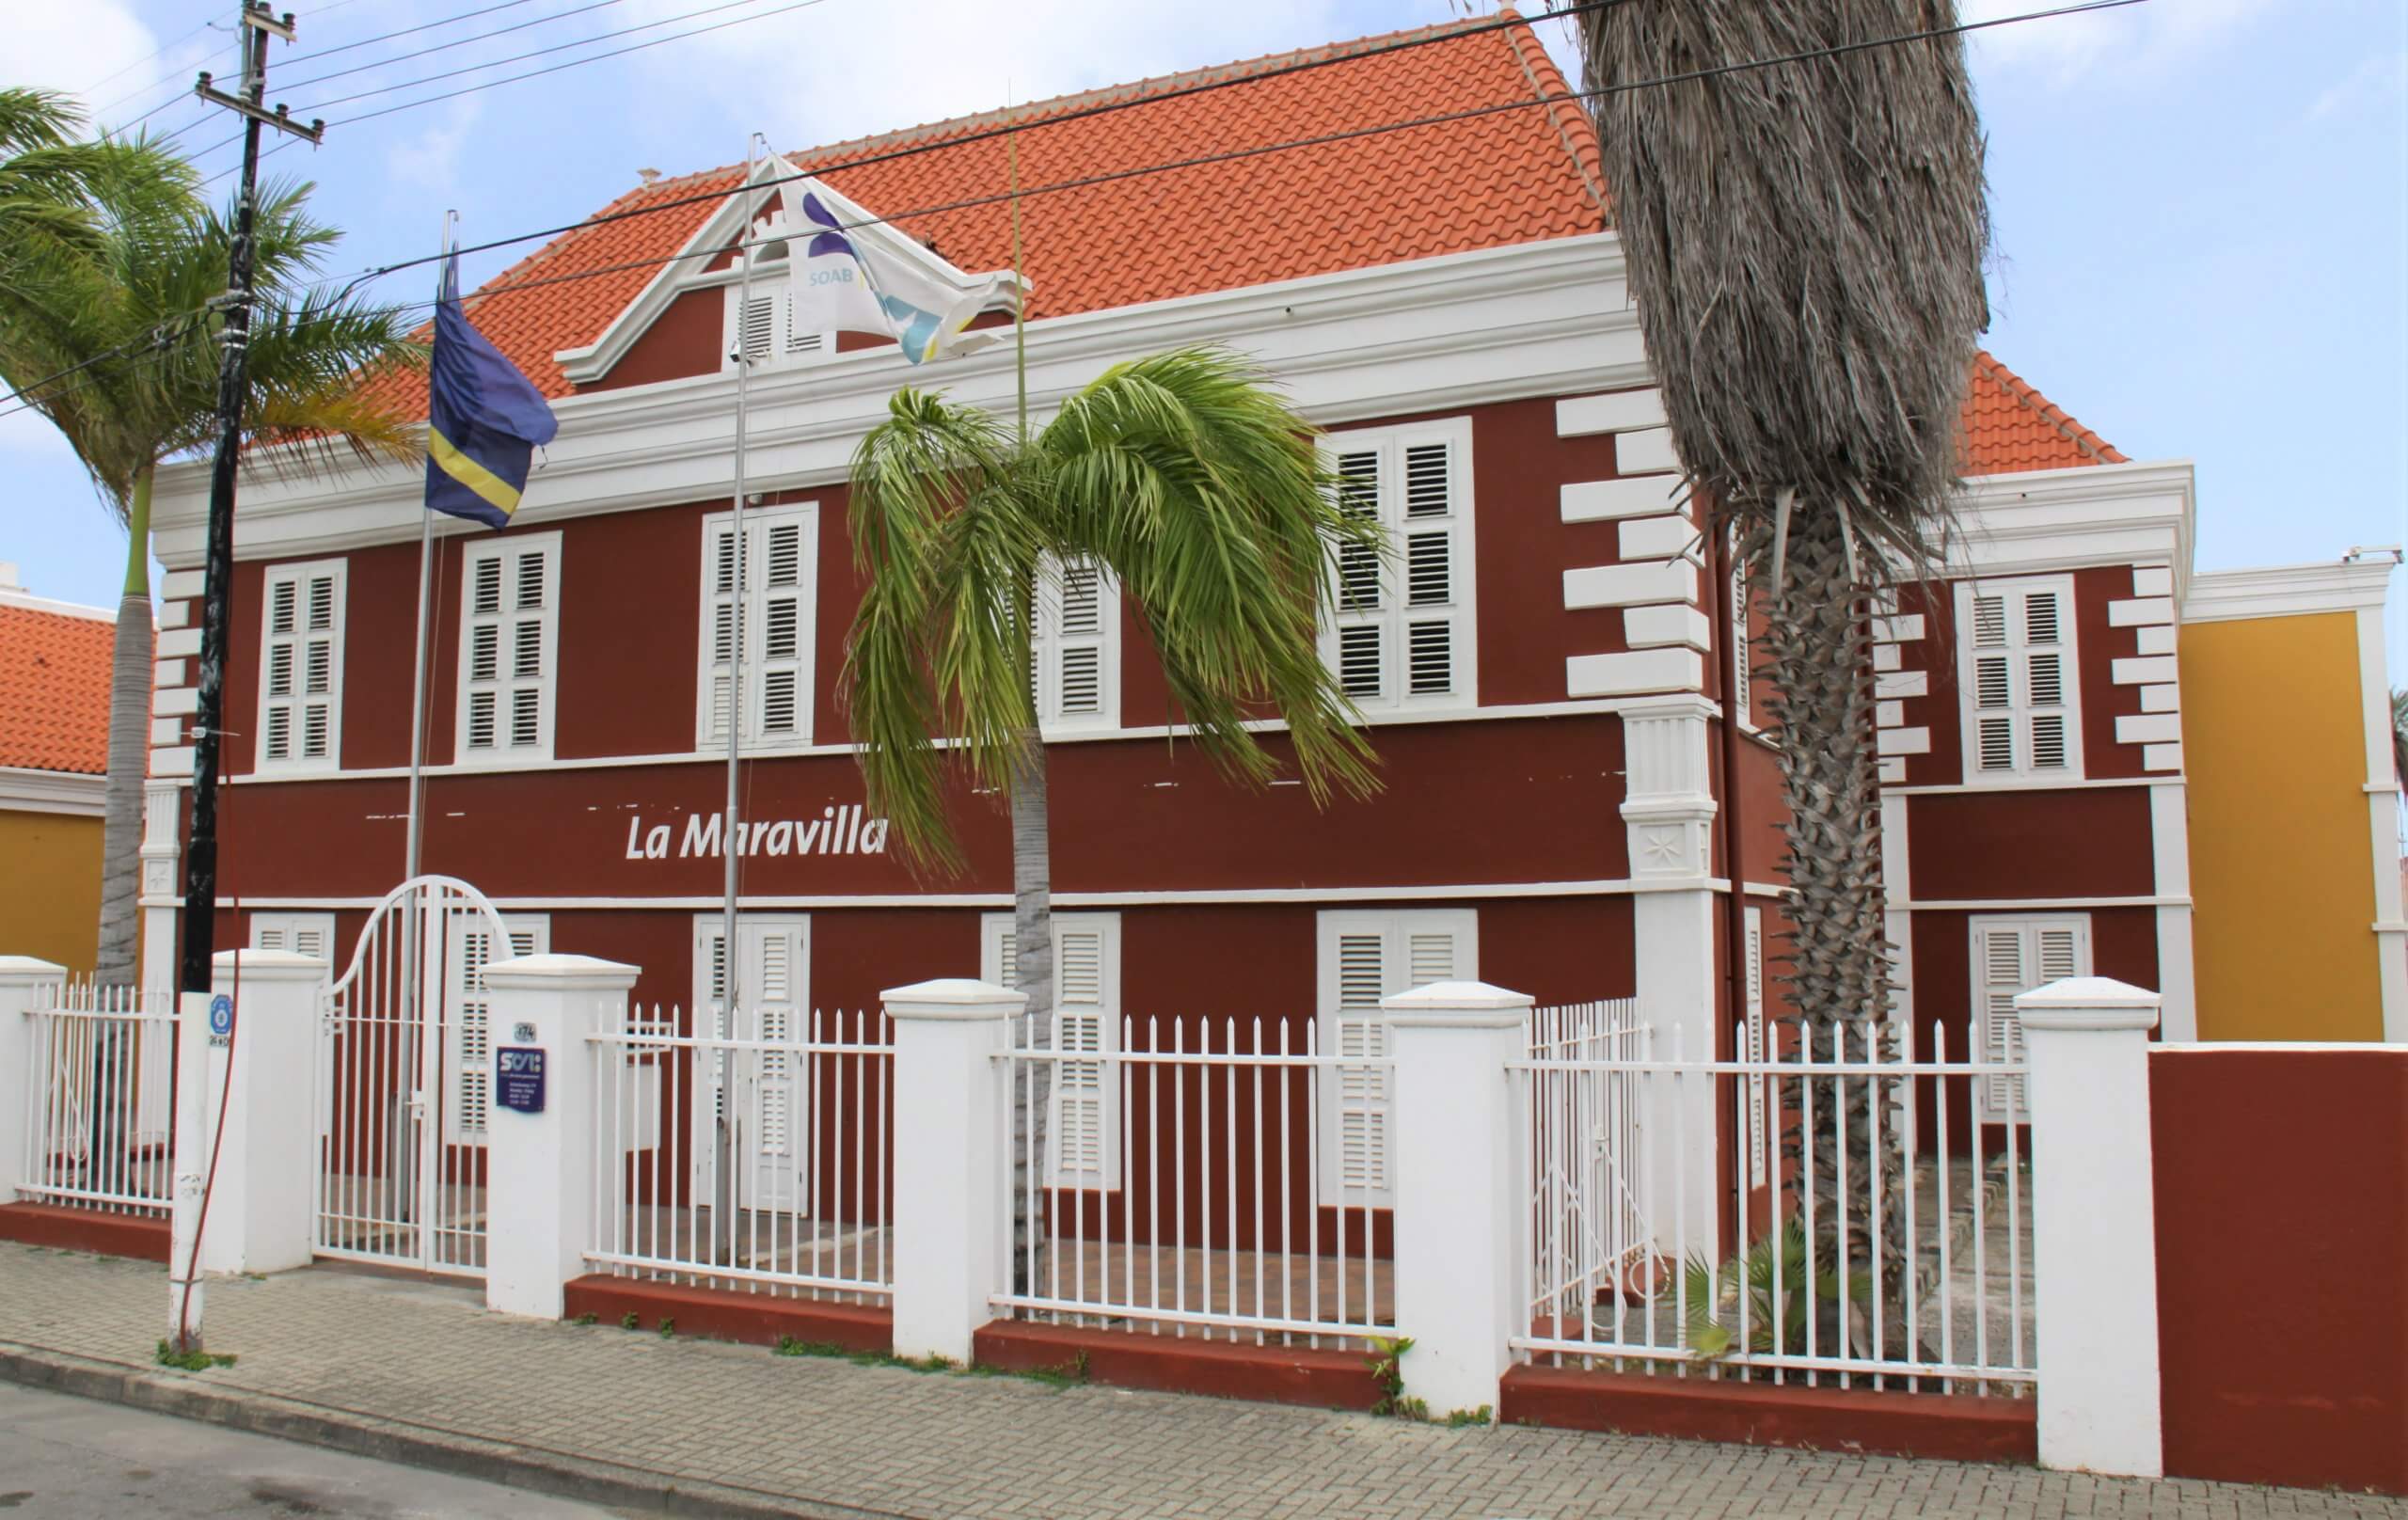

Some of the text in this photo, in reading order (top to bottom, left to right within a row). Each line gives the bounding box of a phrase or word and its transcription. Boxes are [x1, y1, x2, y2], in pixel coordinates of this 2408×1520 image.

[810, 268, 853, 286] SOAB
[626, 804, 888, 860] La Maravilla
